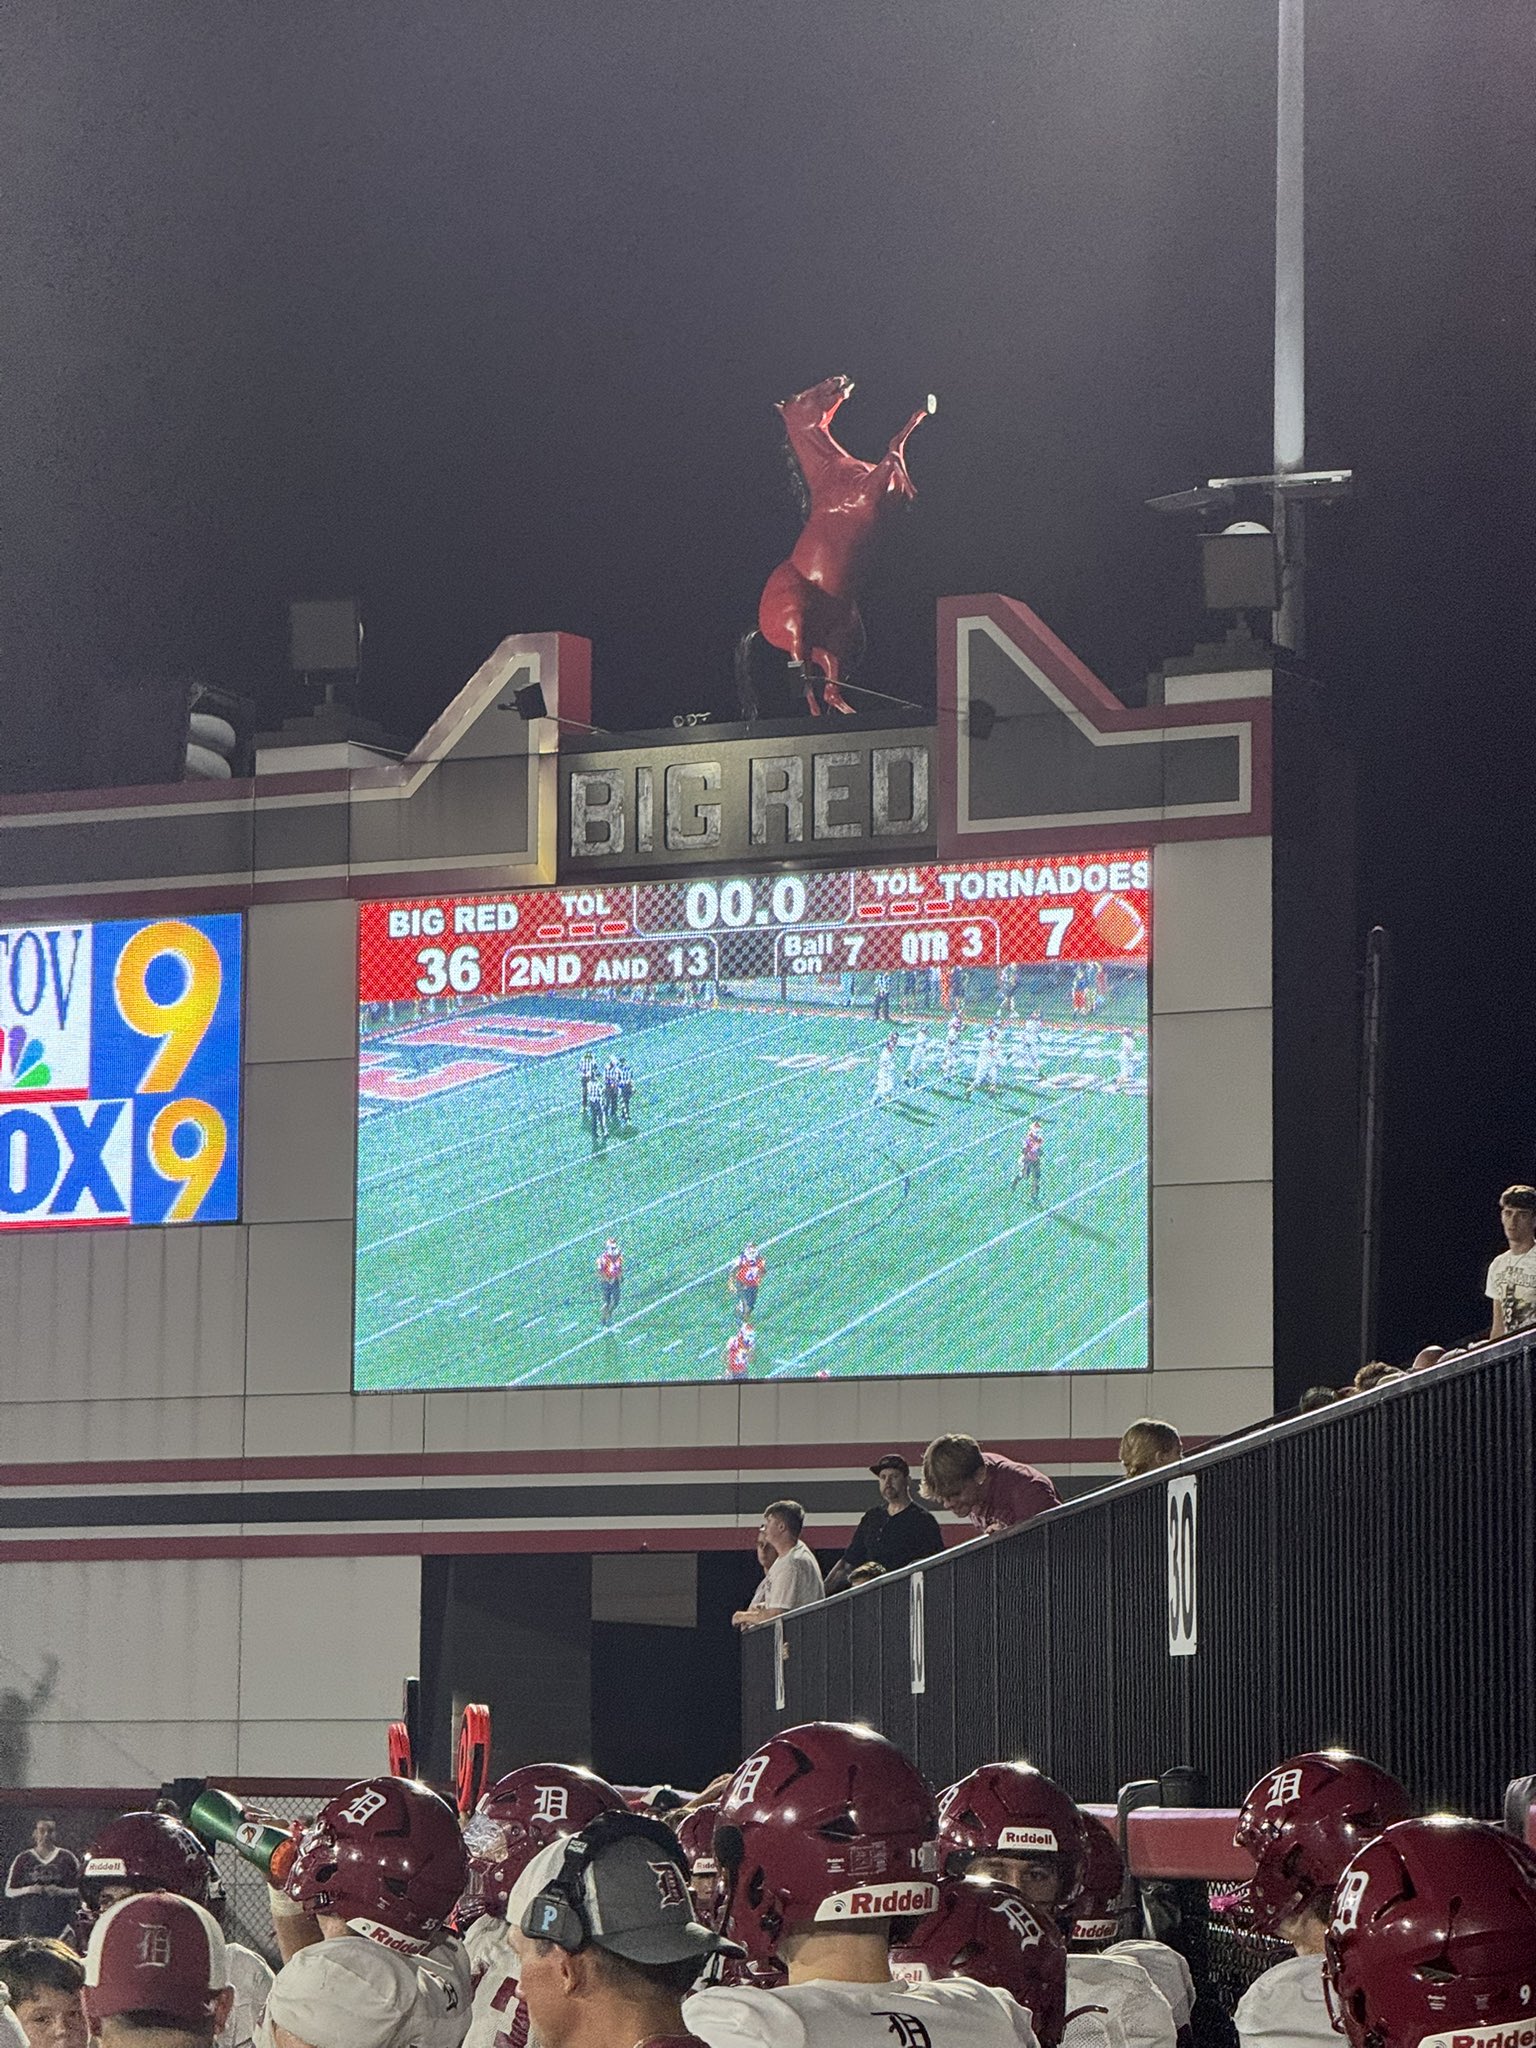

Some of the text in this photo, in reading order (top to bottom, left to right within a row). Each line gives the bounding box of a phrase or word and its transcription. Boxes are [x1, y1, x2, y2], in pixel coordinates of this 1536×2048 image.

[570, 745, 930, 858] BIG RED
[872, 873, 925, 896] TOL
[939, 860, 1149, 902] TORNADOES
[387, 902, 520, 939] BIG RED
[560, 893, 612, 918] TOL
[685, 876, 806, 930] 00.0
[783, 933, 832, 957] Ball
[843, 935, 866, 967] 7
[961, 927, 984, 958] 3
[1037, 907, 1076, 957] 7
[415, 944, 482, 996] 36
[508, 946, 710, 988] 2ND AND 13
[792, 956, 823, 974] on
[113, 920, 222, 1094] 9
[148, 1097, 227, 1224] 9
[1171, 1491, 1194, 1642] 30
[337, 1786, 387, 1827] D
[530, 1785, 569, 1823] D
[1264, 1768, 1302, 1811] D
[1005, 1831, 1053, 1846] Riddell
[541, 1904, 559, 1931] P
[850, 1886, 935, 1915] Riddell
[1330, 1870, 1370, 1935] D
[134, 1921, 172, 1969] D
[989, 1898, 1046, 1951] D
[1519, 1984, 1531, 2006] 9
